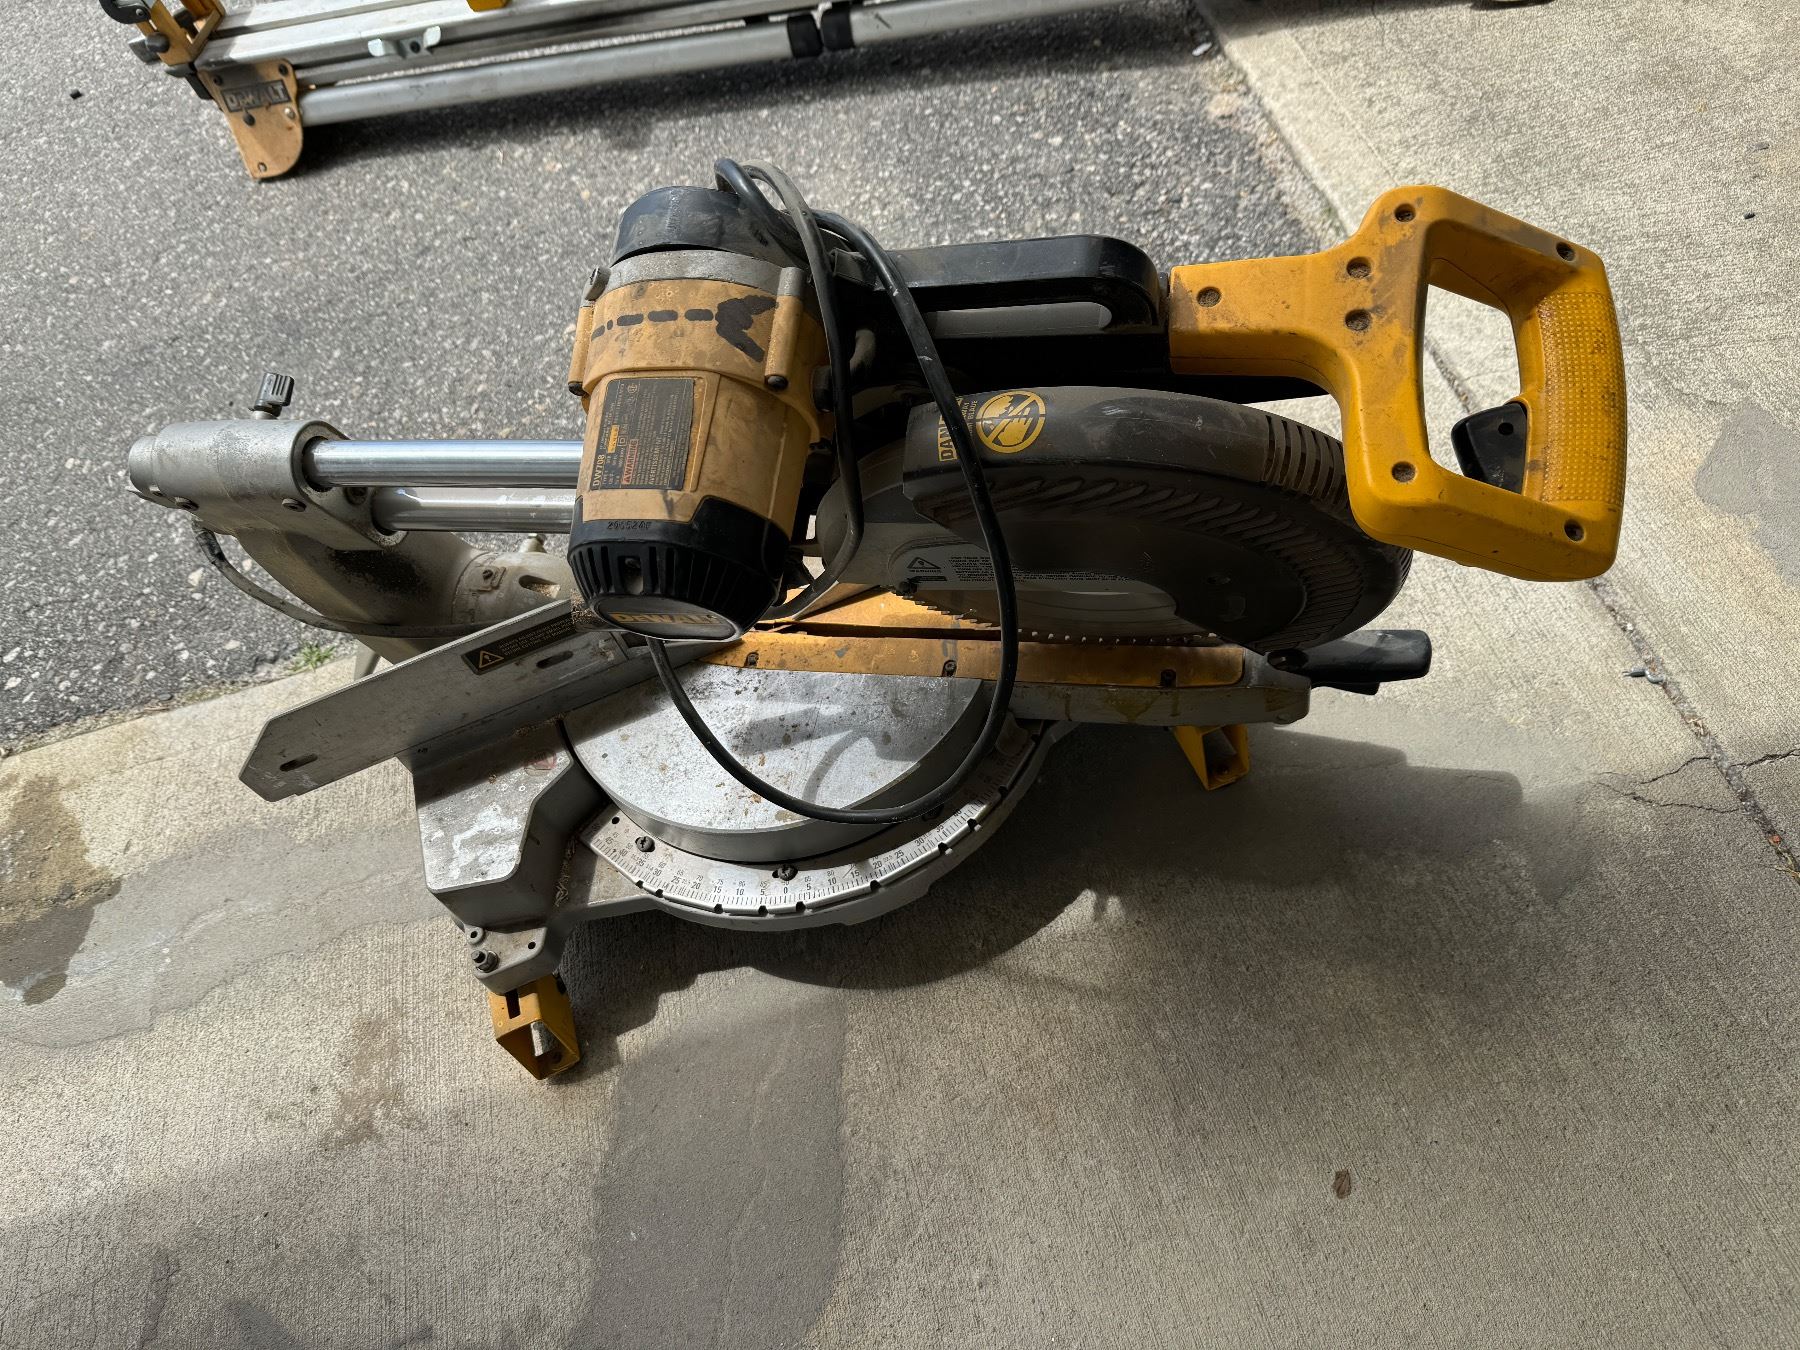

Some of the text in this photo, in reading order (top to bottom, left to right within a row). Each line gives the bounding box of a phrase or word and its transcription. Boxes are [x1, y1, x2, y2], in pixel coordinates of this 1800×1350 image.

[225, 84, 288, 109] DEWALT
[968, 399, 979, 420] BLADE
[592, 454, 606, 487] DW708
[624, 439, 639, 478] WARNING
[652, 868, 662, 877] 30
[670, 875, 681, 885] 25
[690, 881, 701, 890] 20
[713, 885, 722, 894] 15
[735, 888, 745, 896] 10
[760, 888, 766, 896] 5
[783, 886, 789, 895] 0
[806, 882, 812, 891] 5
[827, 876, 837, 886] 10
[850, 868, 860, 879] 15
[872, 860, 883, 870] 20
[894, 849, 905, 860] 25
[914, 837, 925, 847] 30
[935, 823, 945, 833] 35
